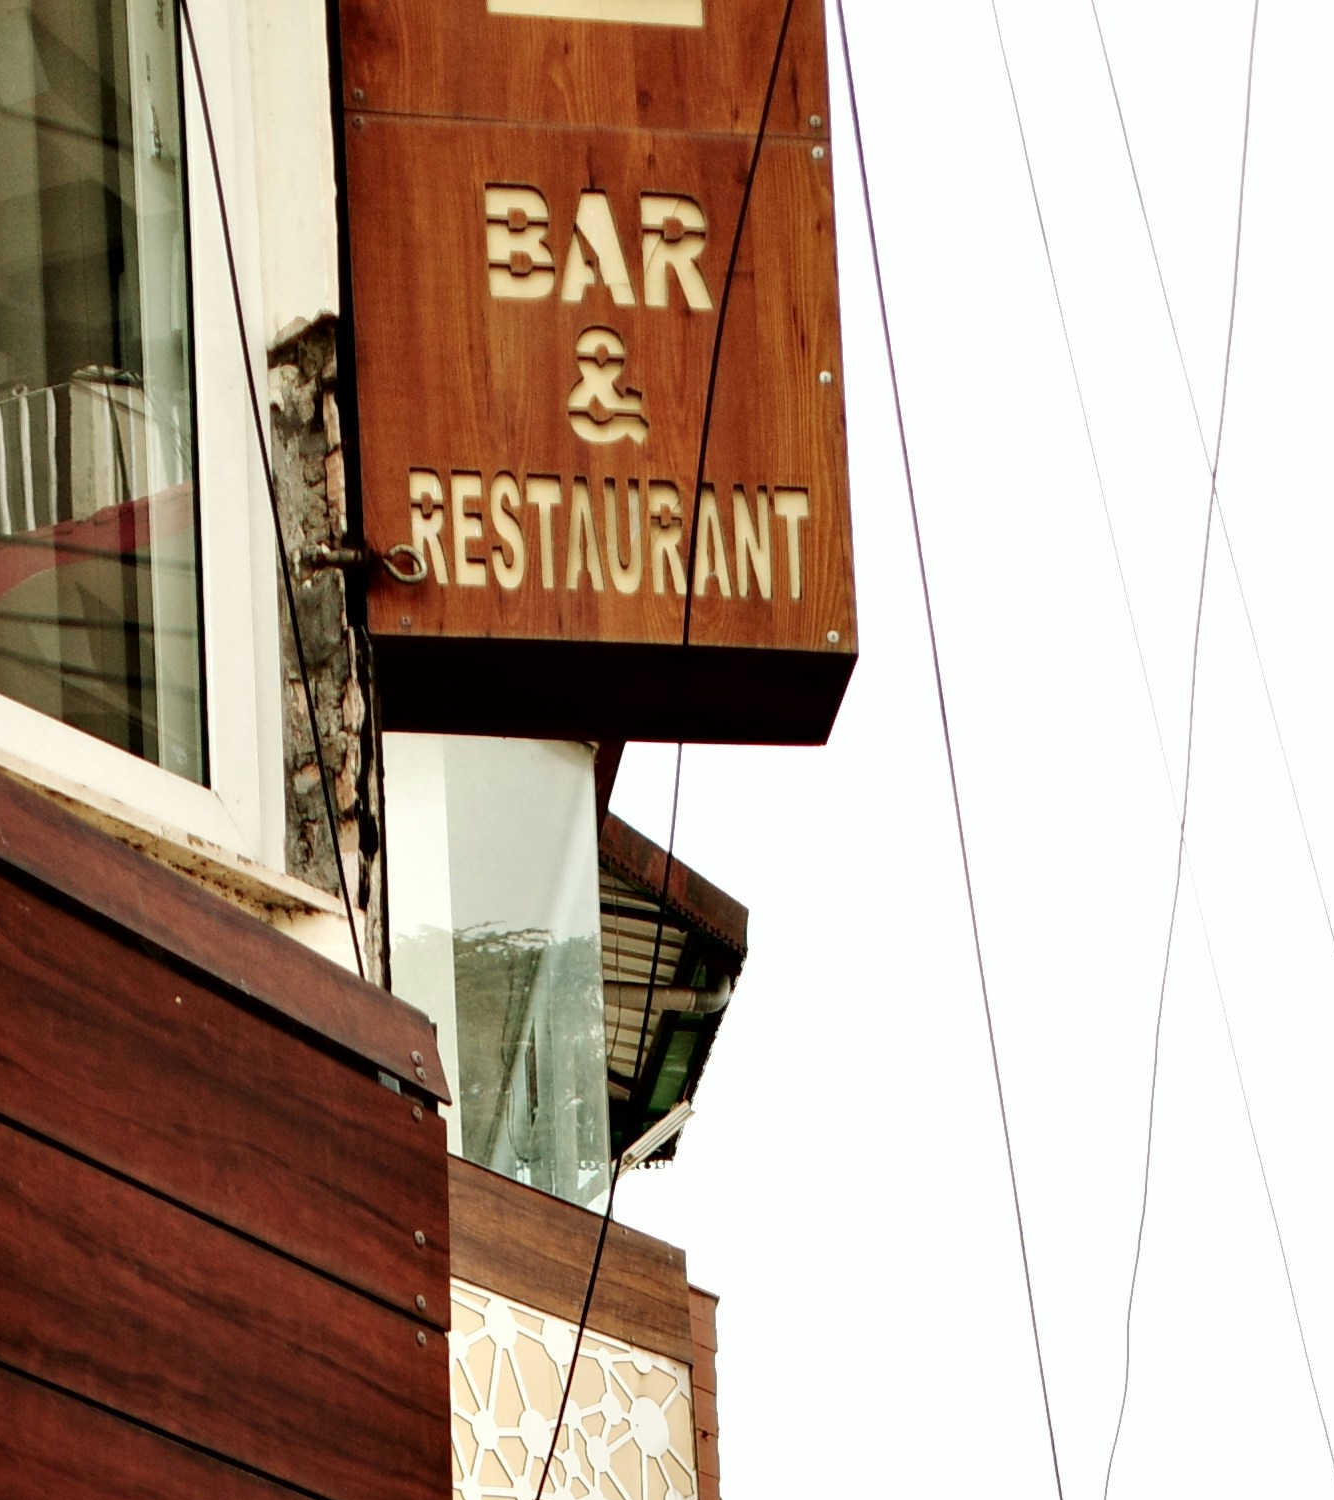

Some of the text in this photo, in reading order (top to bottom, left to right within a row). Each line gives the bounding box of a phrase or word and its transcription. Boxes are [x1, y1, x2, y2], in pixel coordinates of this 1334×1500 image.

[484, 182, 713, 311] BAR
[567, 325, 649, 445] &
[409, 467, 810, 600] RESTAURANT
